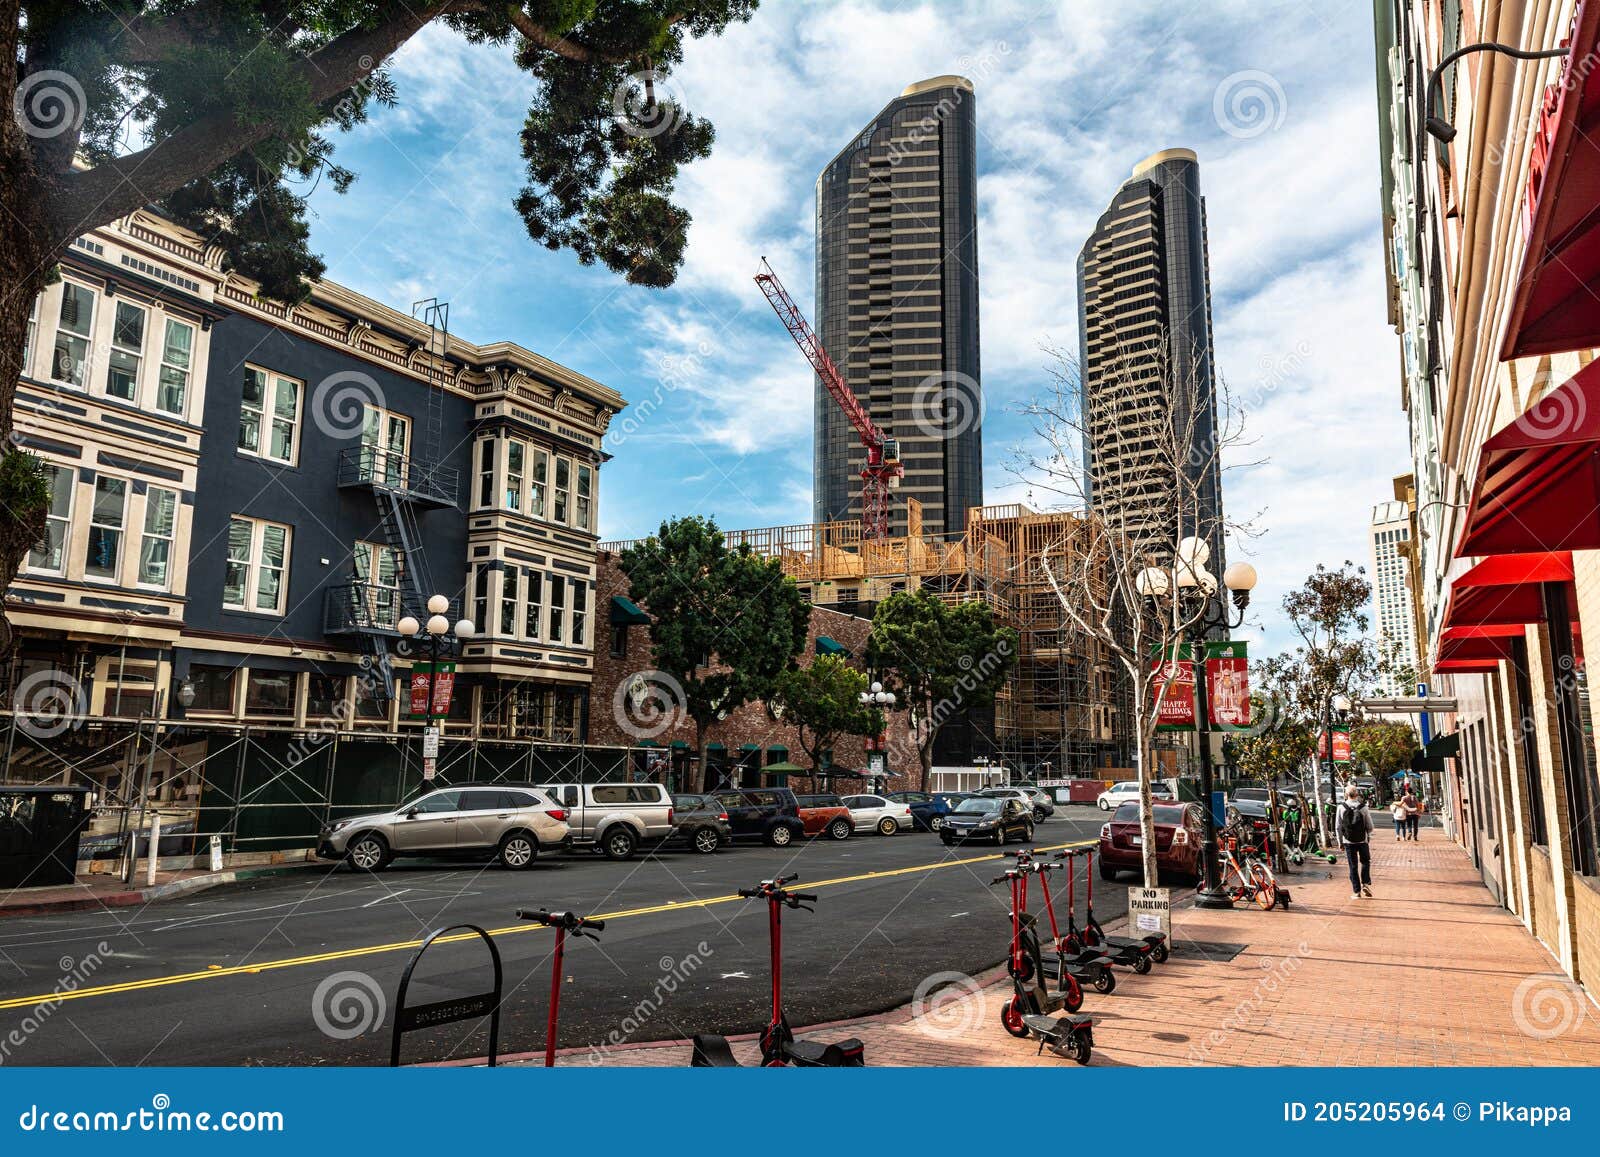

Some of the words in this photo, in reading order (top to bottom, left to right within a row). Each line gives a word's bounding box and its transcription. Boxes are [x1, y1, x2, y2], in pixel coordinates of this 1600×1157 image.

[1163, 700, 1187, 708] HAPPY
[1142, 889, 1157, 899] NO
[1131, 899, 1169, 910] PARKING
